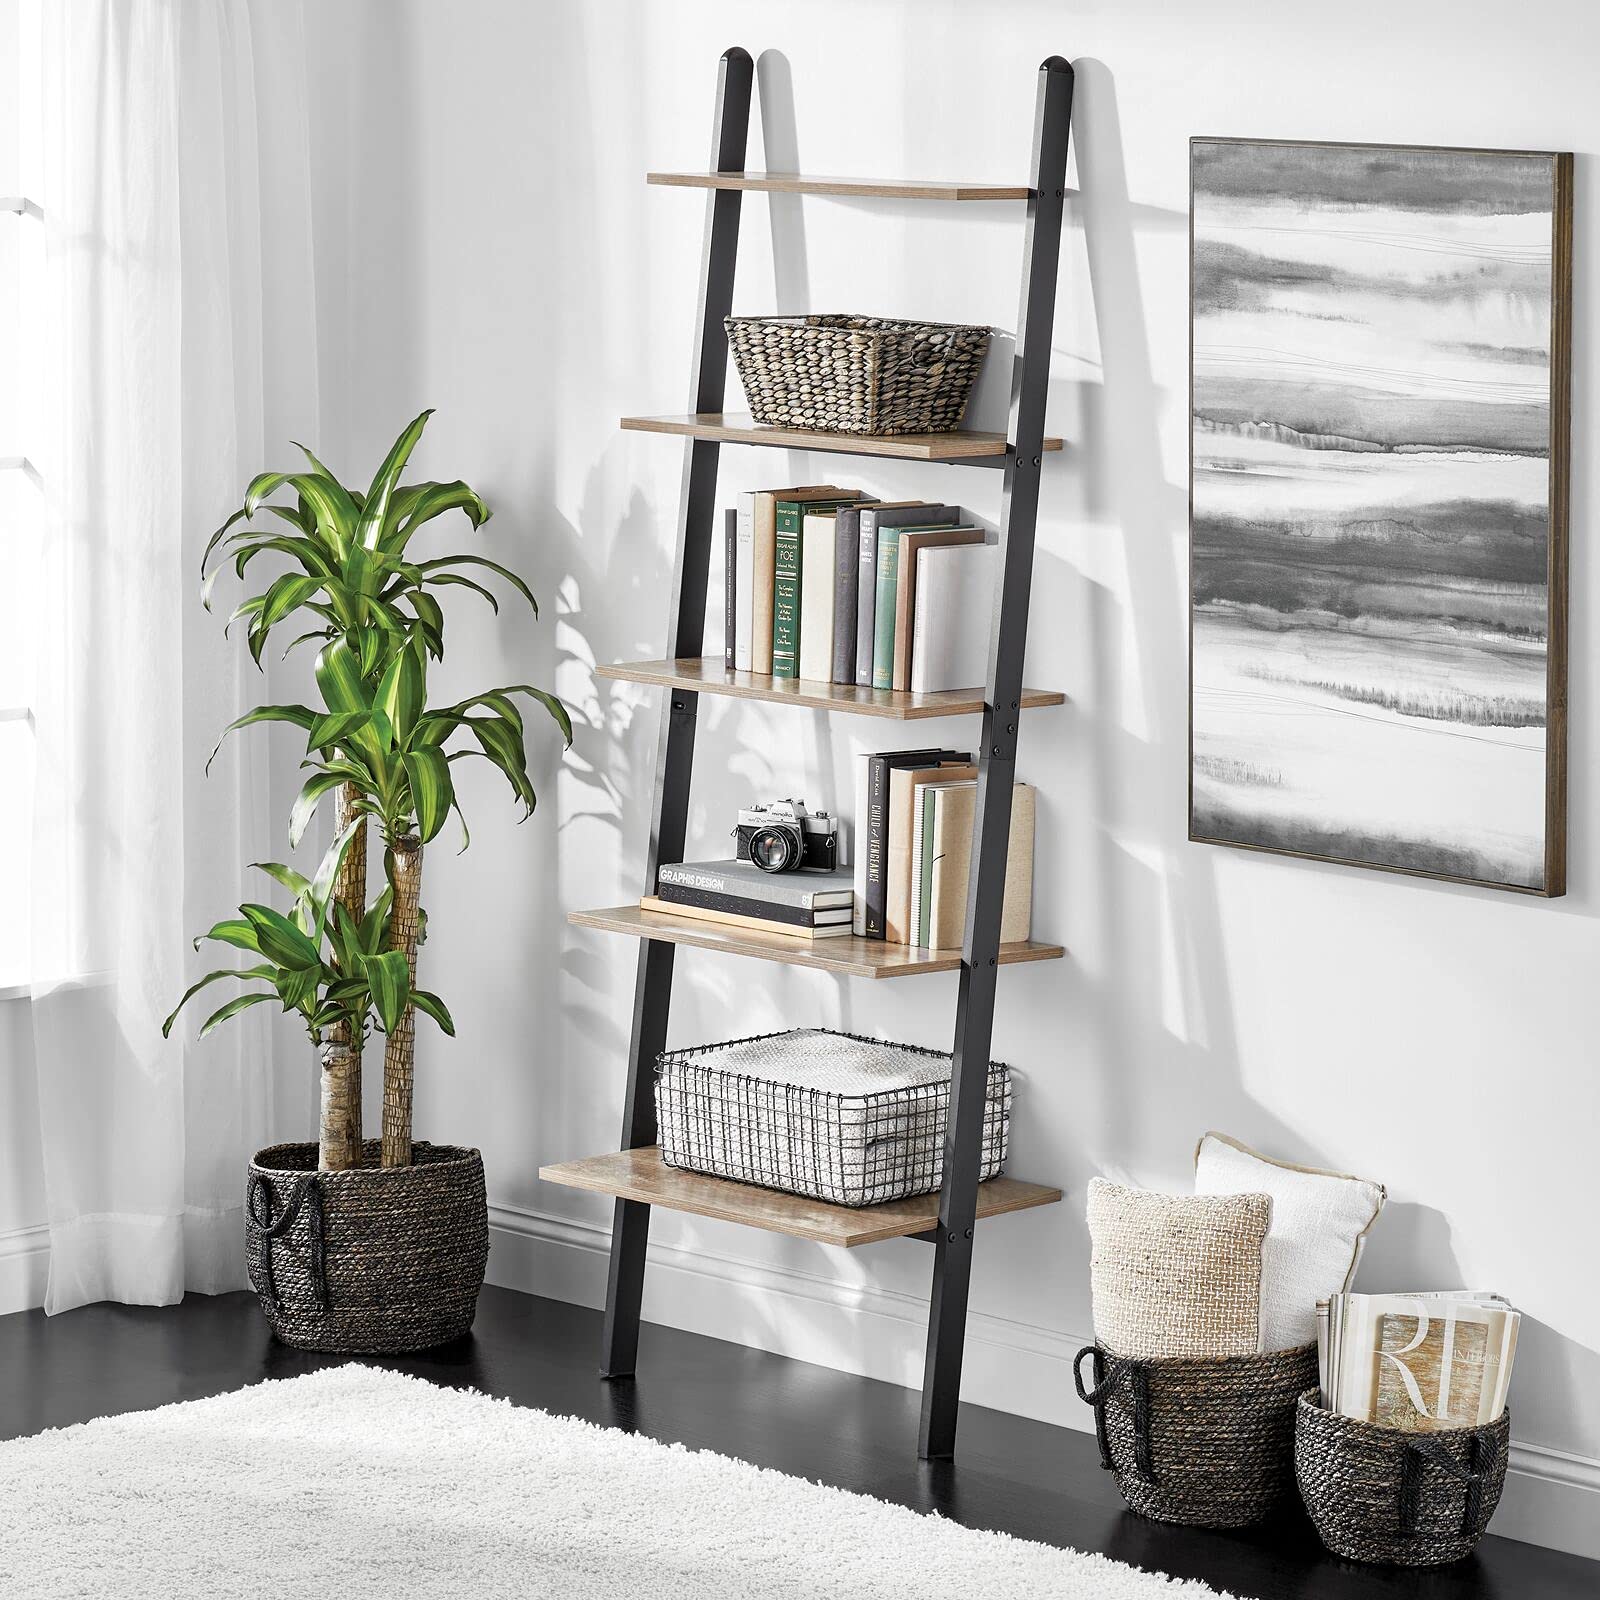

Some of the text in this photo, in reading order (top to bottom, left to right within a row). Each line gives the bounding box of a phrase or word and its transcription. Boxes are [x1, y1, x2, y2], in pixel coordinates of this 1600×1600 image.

[780, 550, 794, 561] POE
[771, 811, 793, 819] minolta
[870, 804, 882, 828] CHILD
[869, 839, 881, 883] VENGEANCE
[660, 869, 695, 886] GRAPHIS
[695, 875, 724, 890] DESIGN
